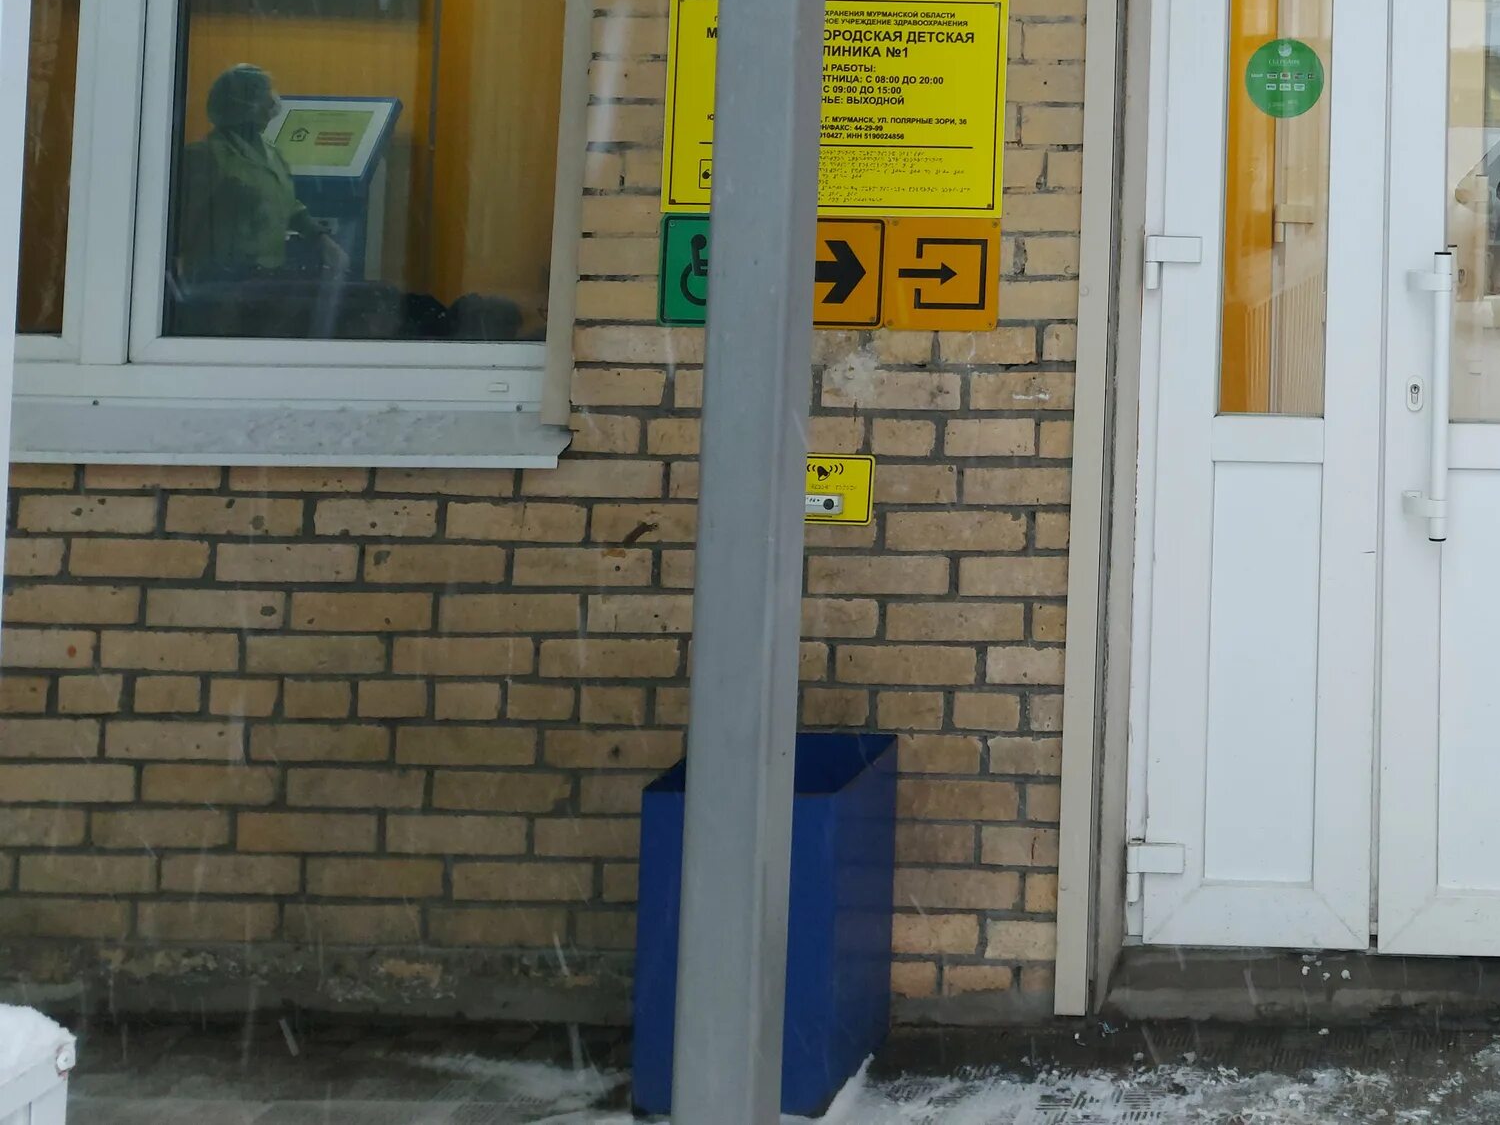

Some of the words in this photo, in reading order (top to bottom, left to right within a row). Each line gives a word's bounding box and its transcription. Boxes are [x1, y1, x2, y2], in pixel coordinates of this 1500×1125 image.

[894, 19, 968, 27] ЗДРАВООХРАНЕНИЯ
[824, 30, 902, 43] ОРОДСКАЯ
[906, 31, 974, 43] ДЕТСКАЯ
[886, 47, 908, 58] №1
[831, 64, 876, 73] РАБОТЫ:
[875, 76, 900, 84] 08:00
[902, 76, 916, 85] ДО
[919, 77, 944, 85] 20:00
[860, 86, 874, 95] ДО
[846, 95, 904, 105] ВЫХОДНОЙ
